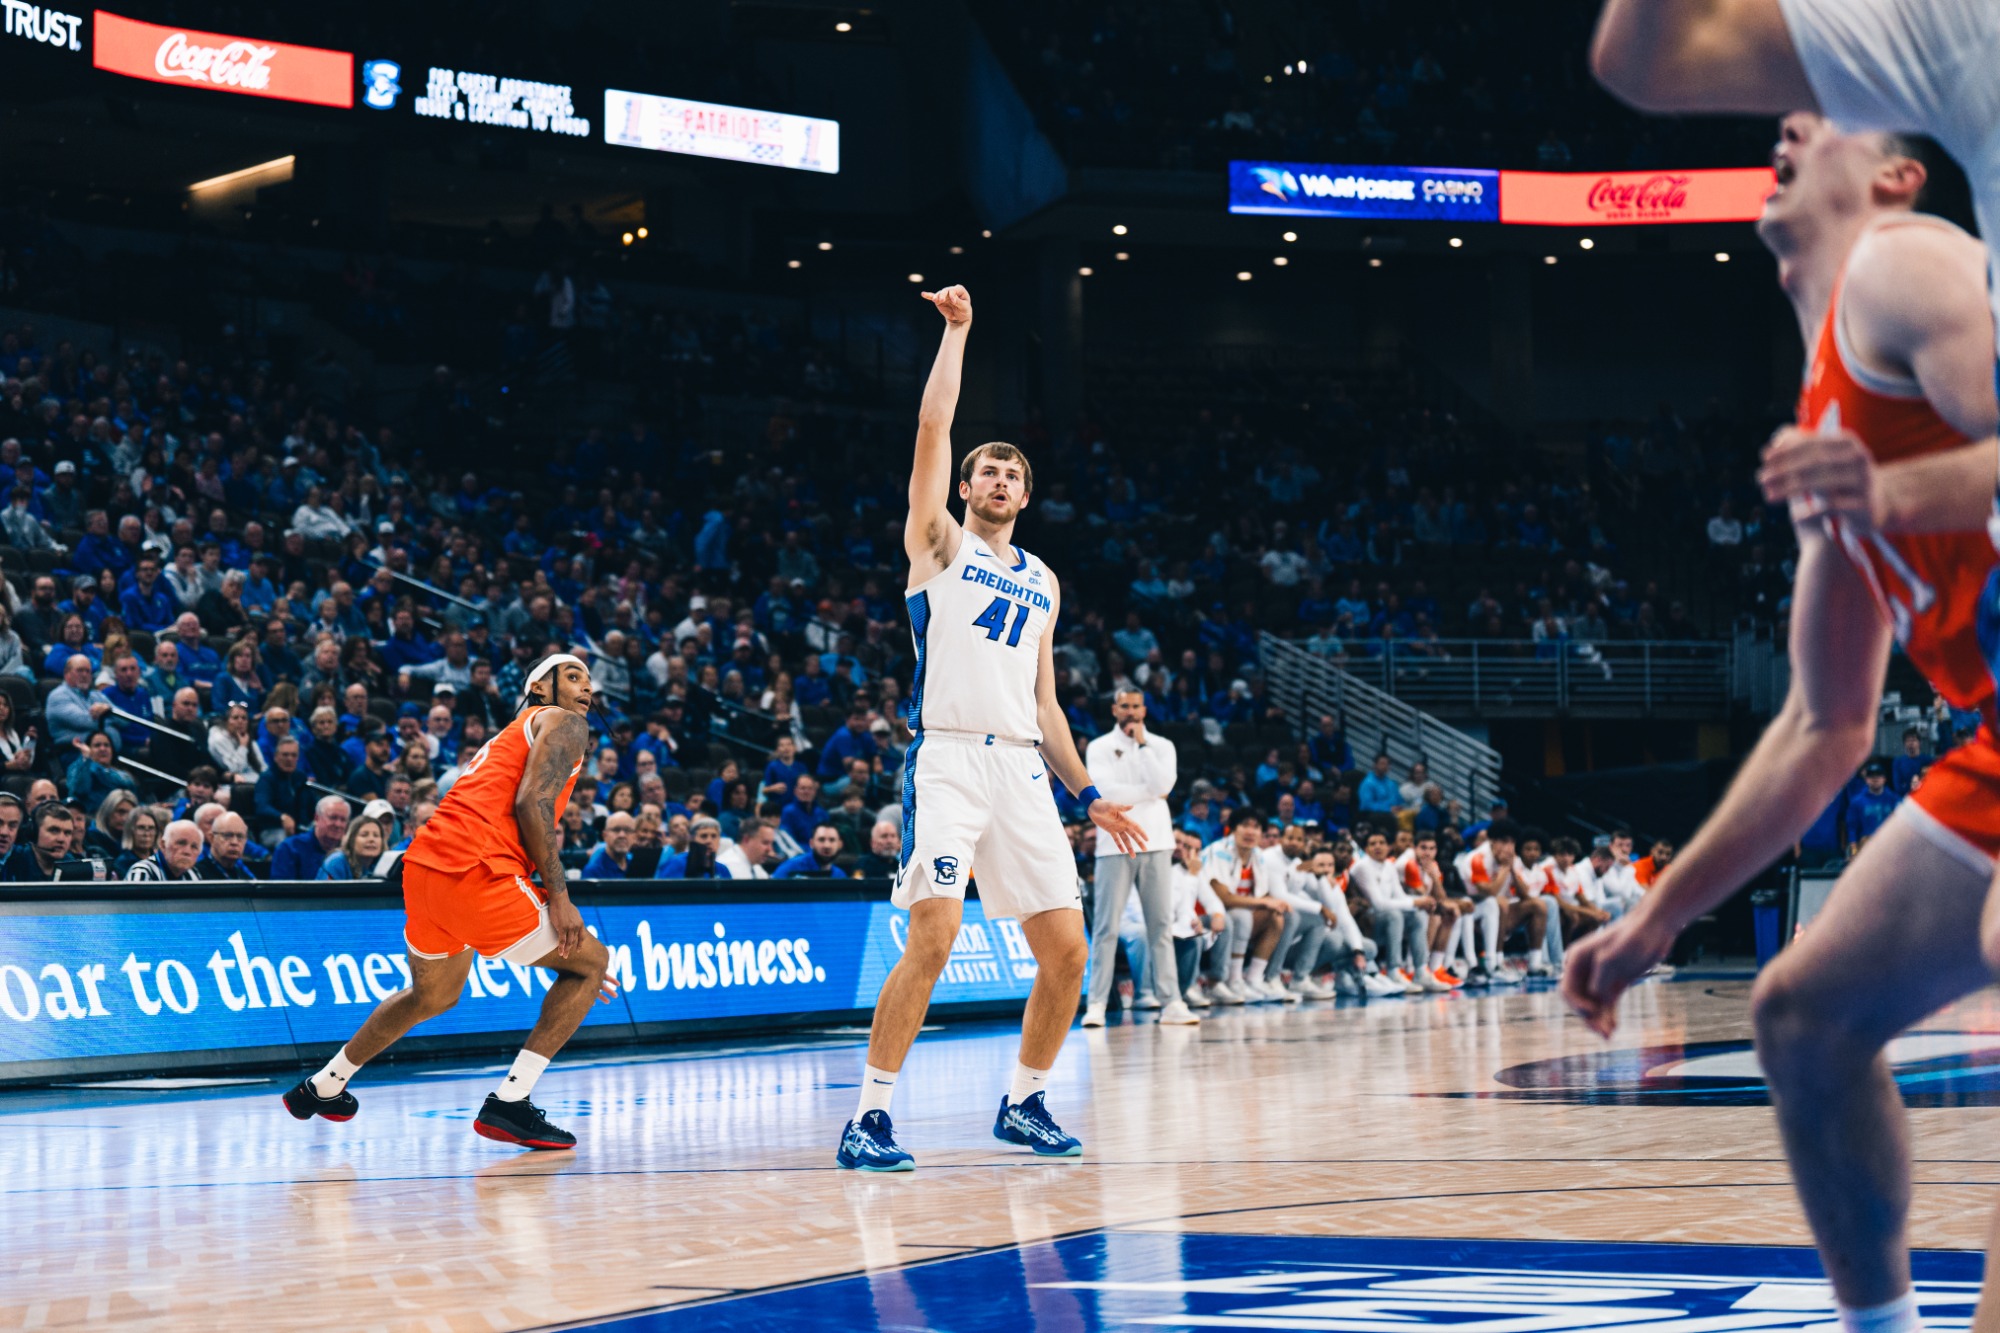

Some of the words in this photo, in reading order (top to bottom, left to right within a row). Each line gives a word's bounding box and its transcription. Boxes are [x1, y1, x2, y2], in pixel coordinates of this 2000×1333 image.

[683, 109, 761, 139] PATRIOT
[961, 564, 1051, 613] CREIGHTON
[972, 595, 1030, 648] 41
[121, 951, 200, 1015] to
[207, 929, 317, 1012] the
[637, 920, 826, 991] business.
